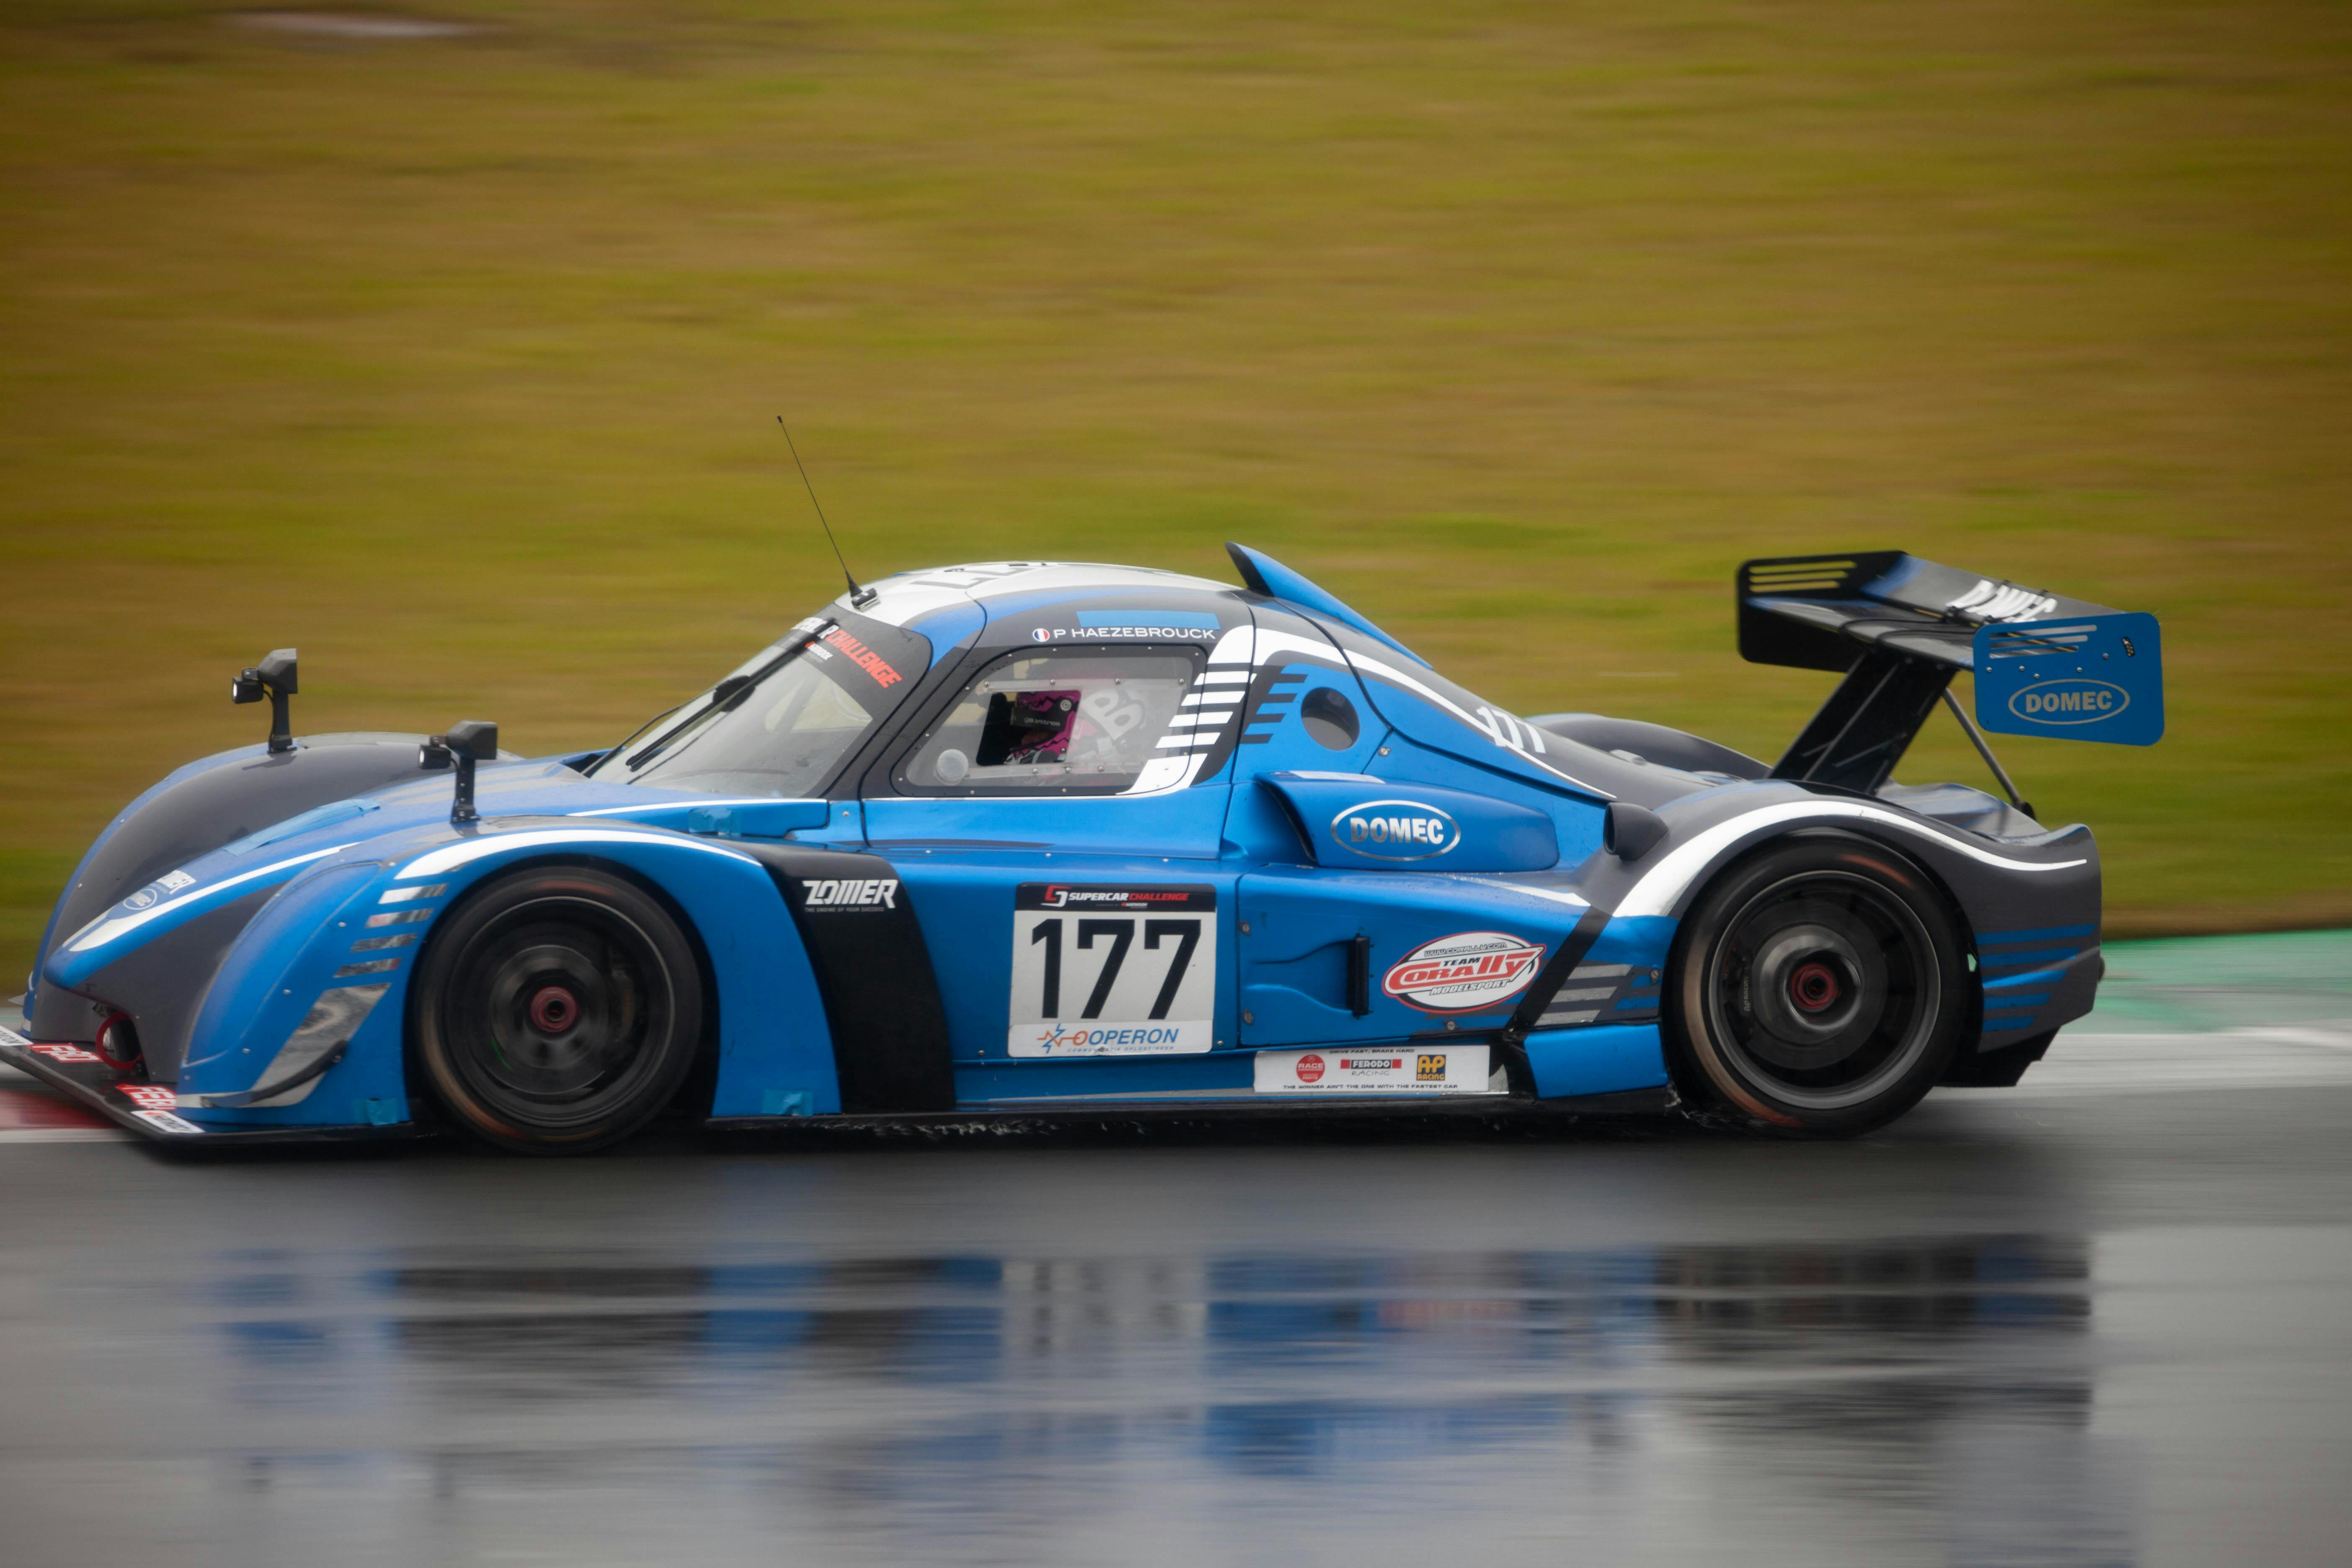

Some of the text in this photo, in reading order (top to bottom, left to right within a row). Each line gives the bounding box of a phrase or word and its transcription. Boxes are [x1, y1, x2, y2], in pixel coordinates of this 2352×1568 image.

[1054, 627, 1216, 640] P HAEZEBROUCK
[825, 629, 902, 688] CHALLENGE
[2025, 691, 2112, 712] DOMEC
[1476, 706, 1546, 753] 177
[1350, 817, 1444, 844] DOMEC
[802, 879, 899, 908] ZOMER
[1032, 918, 1202, 1020] 177
[1443, 957, 1481, 967] TEAM
[1429, 980, 1510, 995] MODELSPORT
[1352, 1060, 1390, 1068] FERODO
[1418, 1055, 1445, 1073] AP
